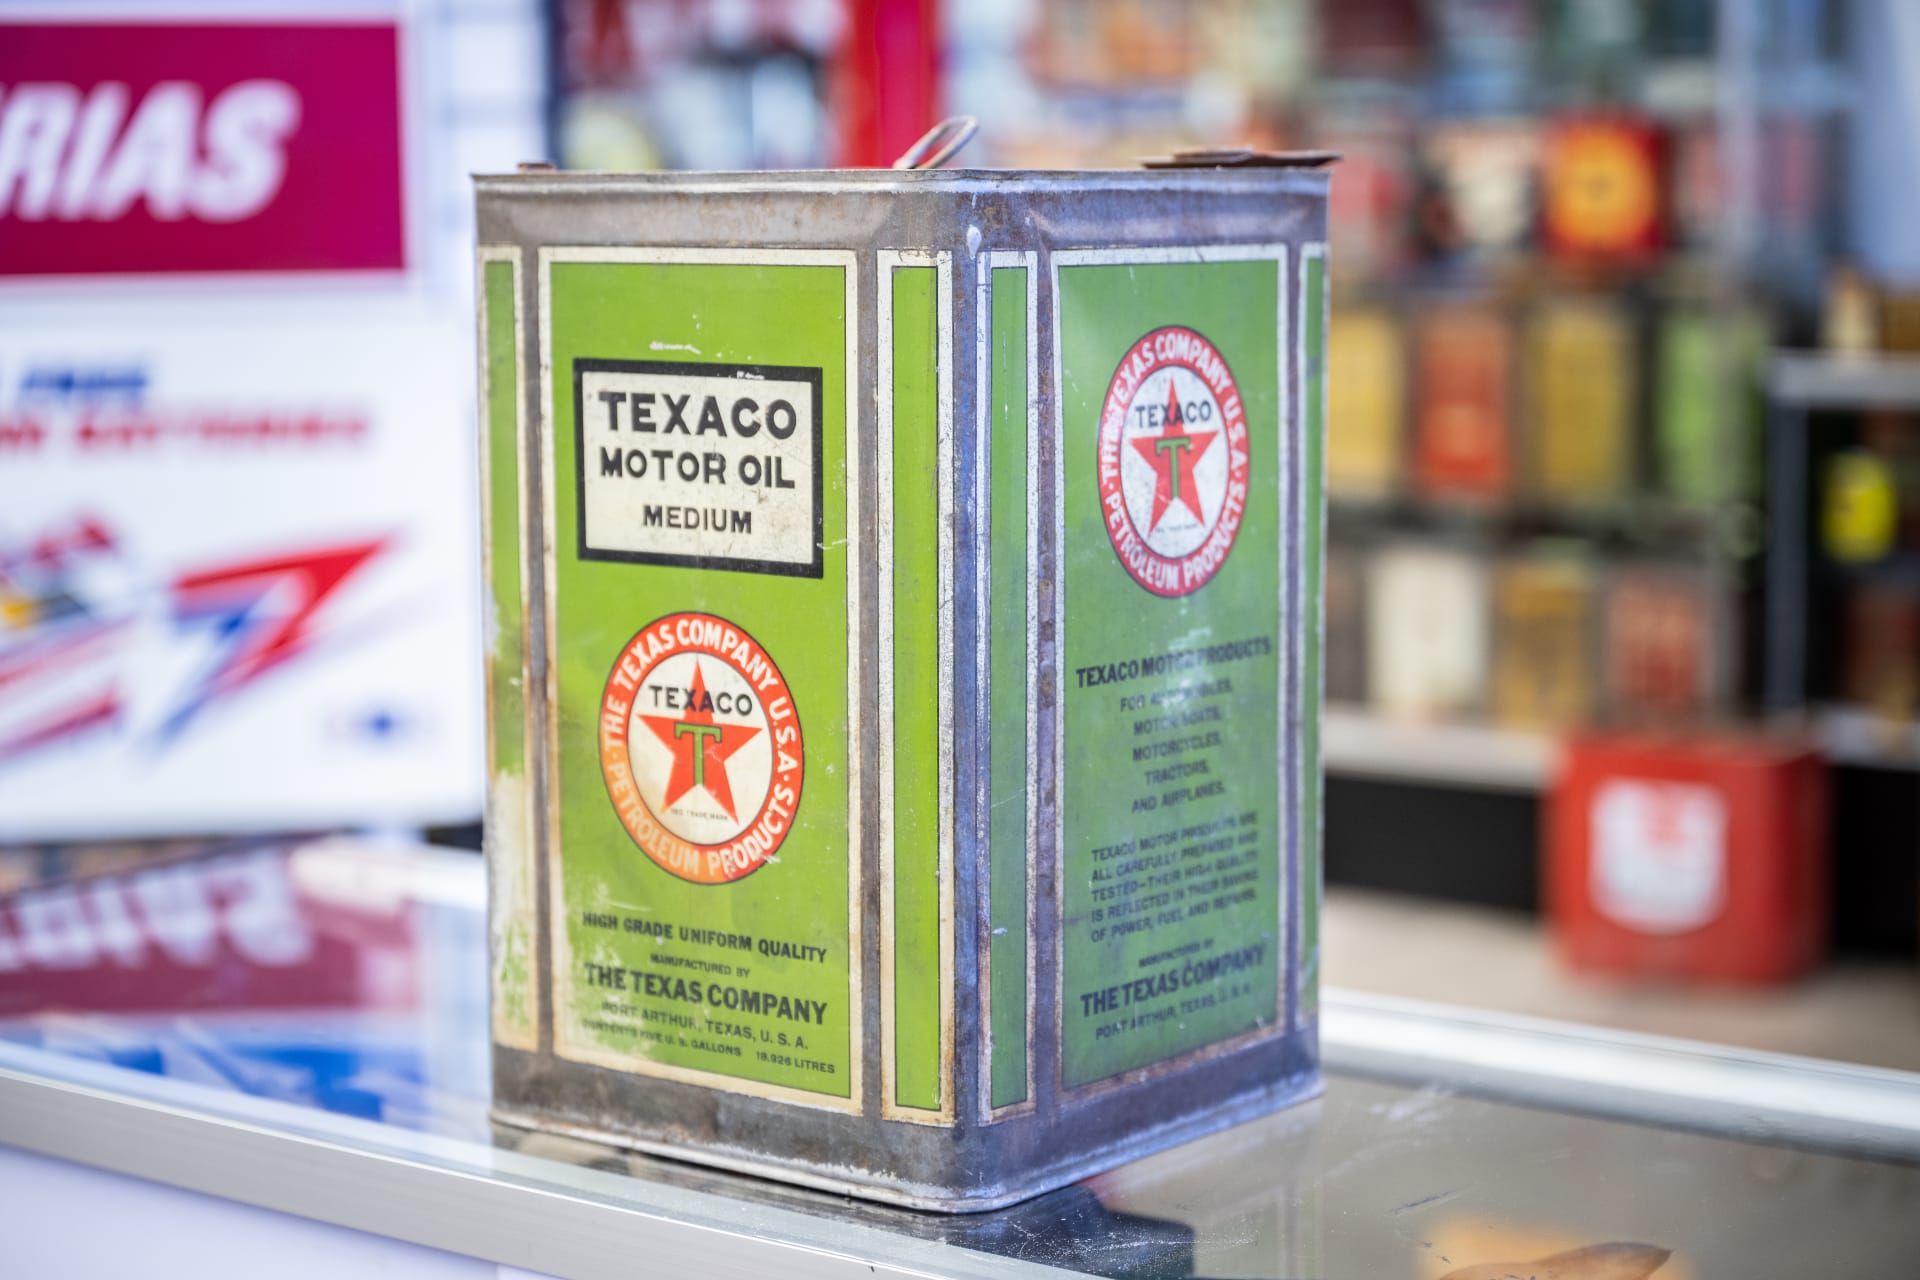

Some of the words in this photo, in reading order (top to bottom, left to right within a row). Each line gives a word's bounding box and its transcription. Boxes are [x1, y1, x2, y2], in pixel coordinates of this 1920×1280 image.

[0, 79, 303, 224] RIAS
[1108, 342, 1155, 419] TEXAS
[1155, 332, 1232, 394] COMPANY
[598, 391, 797, 440] TEXACO
[1135, 401, 1212, 428] TEXACO
[600, 446, 727, 484] MOTOR
[738, 455, 796, 489] OIL
[643, 504, 752, 534] MEDIUM
[1105, 491, 1179, 590] PETROLEUM
[1183, 482, 1246, 588] PRODUCTS
[613, 624, 675, 692] TEXAS
[676, 619, 778, 691] COMPANY
[1076, 660, 1139, 689] TEXACO
[1198, 636, 1271, 665] PRODUCTS
[602, 696, 627, 752] THE
[649, 685, 753, 716] TEXACO
[674, 722, 722, 786] T
[608, 761, 699, 875] PETROLEUM
[708, 783, 795, 877] PRODUCTS
[1132, 796, 1158, 813] AND
[1092, 840, 1136, 863] TEXACO
[1139, 832, 1179, 851] MOTOR
[1092, 868, 1111, 882] ALL
[1116, 851, 1177, 877] CAREFULLY
[1092, 908, 1104, 923] IS
[1107, 891, 1170, 919] REFLECTED
[583, 911, 618, 930] HIGH
[623, 917, 673, 940] GRADE
[679, 926, 753, 951] UNIFORM
[758, 939, 828, 963] QUALITY
[1091, 928, 1108, 943] OF
[650, 952, 732, 976] MANUFACTURED
[736, 966, 751, 979] BY
[1080, 987, 1120, 1017] THE
[1120, 968, 1179, 1006] TEXAS
[1181, 944, 1267, 987] COMPANY
[583, 962, 627, 991] THE
[629, 970, 703, 1004] TEXAS
[707, 983, 828, 1025] COMPANY
[690, 1039, 742, 1057] GALLONS
[794, 1056, 836, 1075] LITRES
[705, 1020, 757, 1043] TEXAS,
[760, 1028, 774, 1044] U.
[777, 1033, 791, 1048] S.
[795, 1035, 809, 1050] A.
